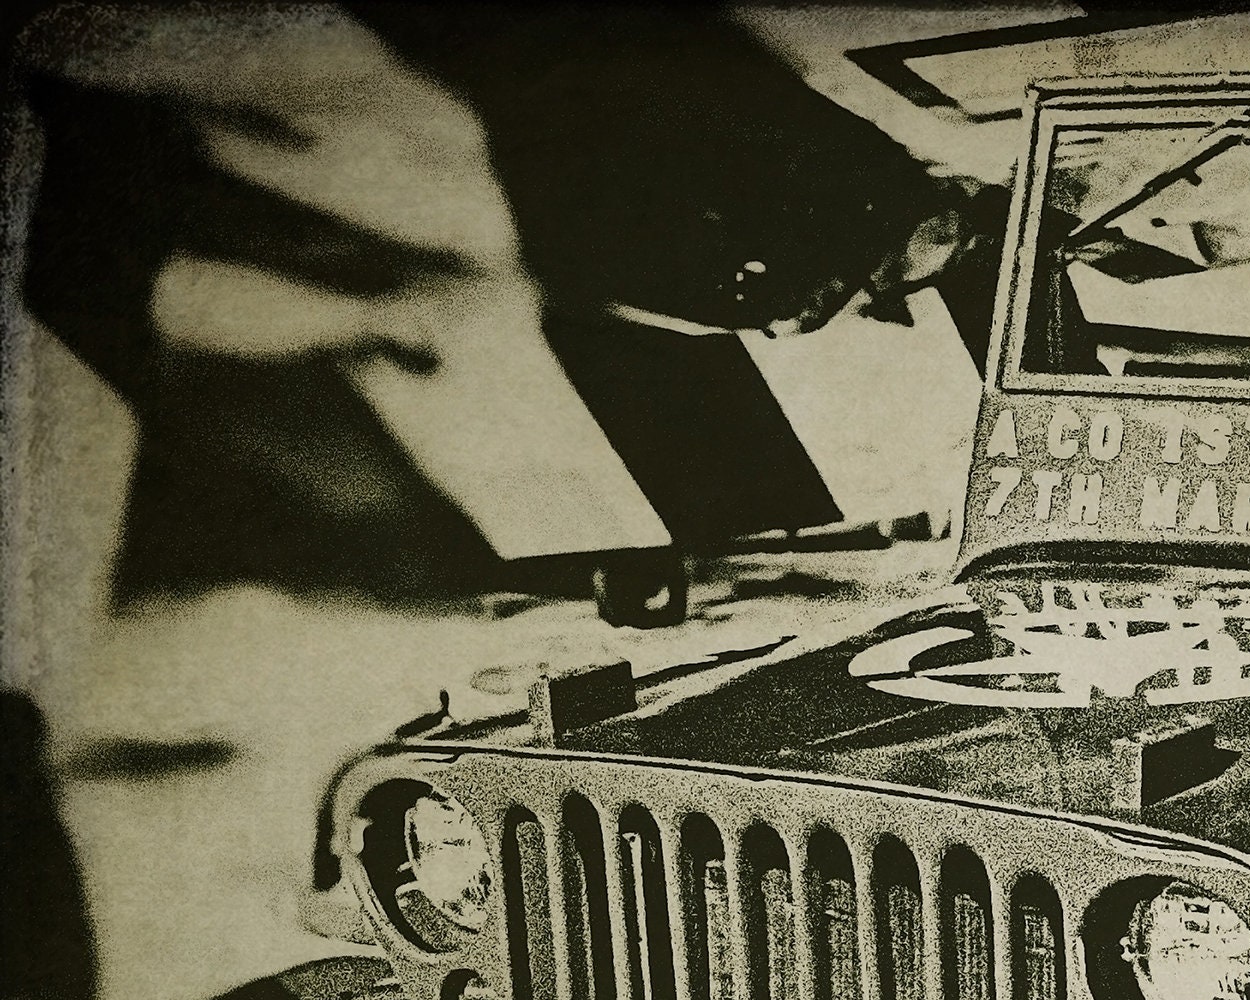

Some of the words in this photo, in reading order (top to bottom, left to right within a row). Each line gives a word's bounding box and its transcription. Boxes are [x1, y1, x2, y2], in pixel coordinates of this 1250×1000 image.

[987, 410, 1018, 459] A
[1047, 409, 1124, 461] CO
[985, 466, 1103, 525] 7TH
